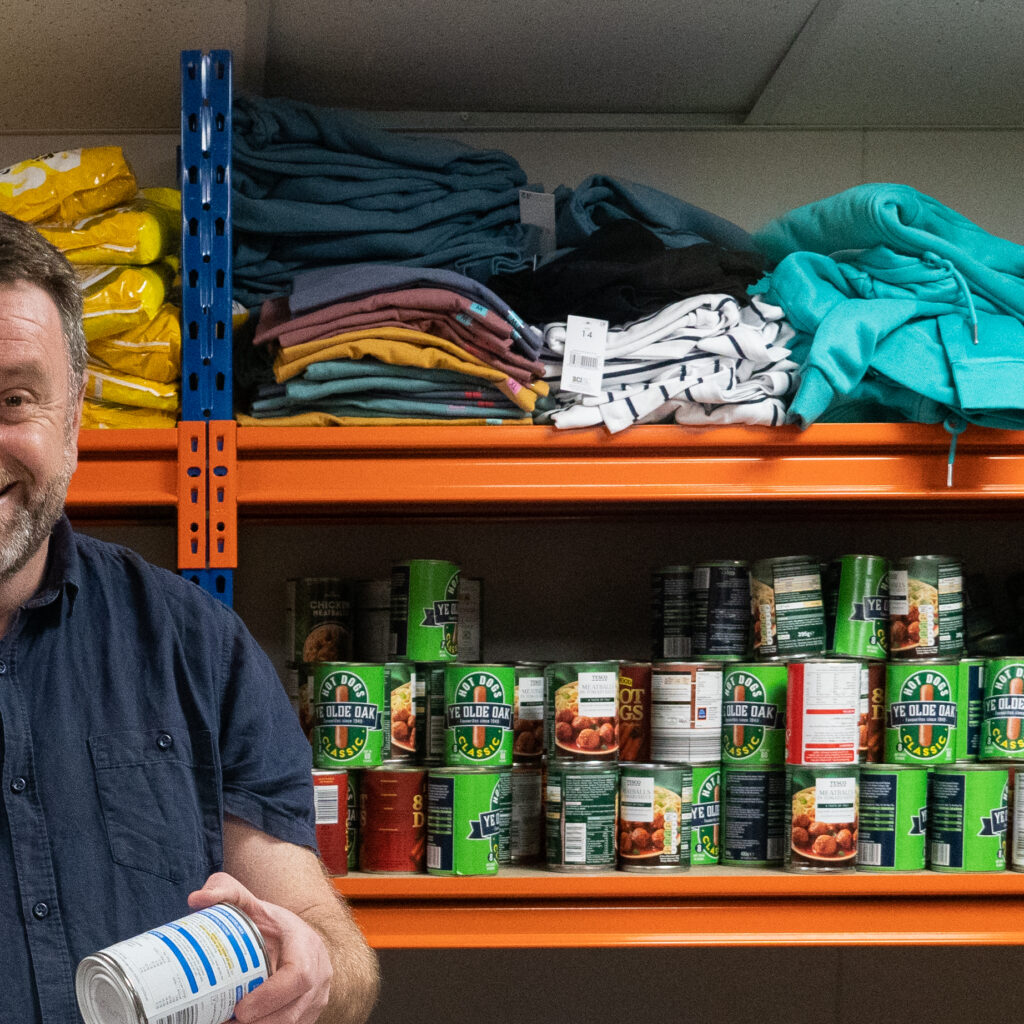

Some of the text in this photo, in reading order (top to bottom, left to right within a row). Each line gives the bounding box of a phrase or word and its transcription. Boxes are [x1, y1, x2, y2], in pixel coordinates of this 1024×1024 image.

[322, 675, 365, 698] HOT DOGS
[458, 675, 503, 698] HOT DOGS
[739, 675, 763, 698] DOGS
[904, 674, 948, 697] HOT DOGS
[995, 669, 1012, 690] HOT
[326, 703, 351, 717] OLDE
[354, 704, 375, 719] OAK
[449, 704, 511, 719] YE OLDE OAK
[751, 706, 774, 718] OAK
[893, 705, 956, 717] YE OLDE OAK
[985, 700, 996, 711] YE
[323, 736, 363, 758] CLASSIC
[459, 737, 500, 758] CLASSIC
[903, 735, 947, 756] CLASSIC
[702, 780, 715, 797] HOT
[483, 814, 494, 828] YE
[692, 805, 705, 819] YE
